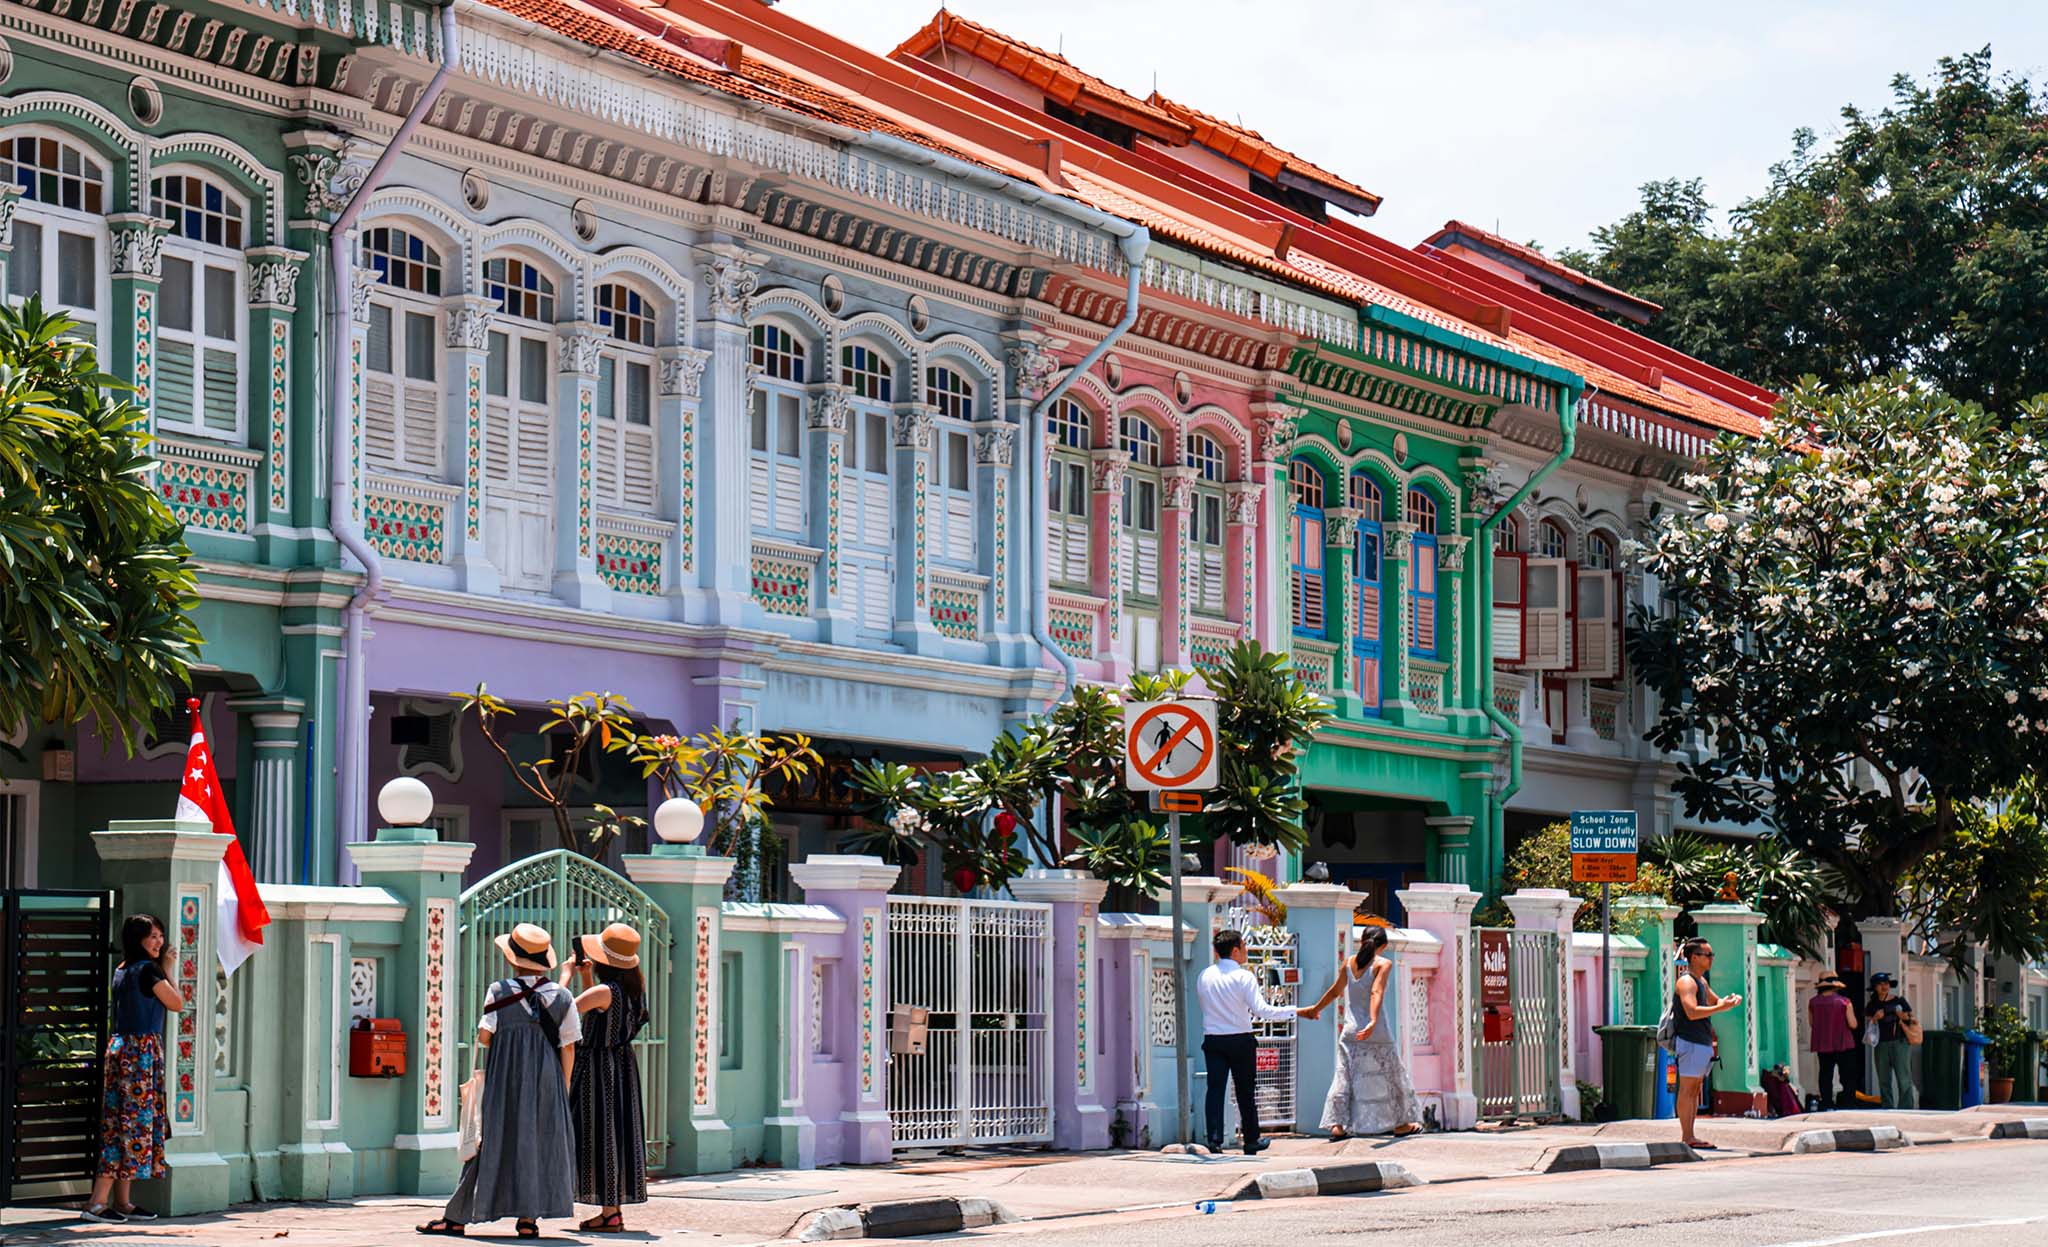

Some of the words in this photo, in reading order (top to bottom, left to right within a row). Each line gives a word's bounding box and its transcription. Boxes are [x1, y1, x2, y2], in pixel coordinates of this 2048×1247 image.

[1580, 816, 1606, 824] School
[1610, 816, 1628, 824] Zone
[1573, 826, 1594, 834] Drive
[1598, 826, 1635, 836] Carefully
[1573, 838, 1601, 848] SLOW
[1604, 838, 1636, 848] DOWN
